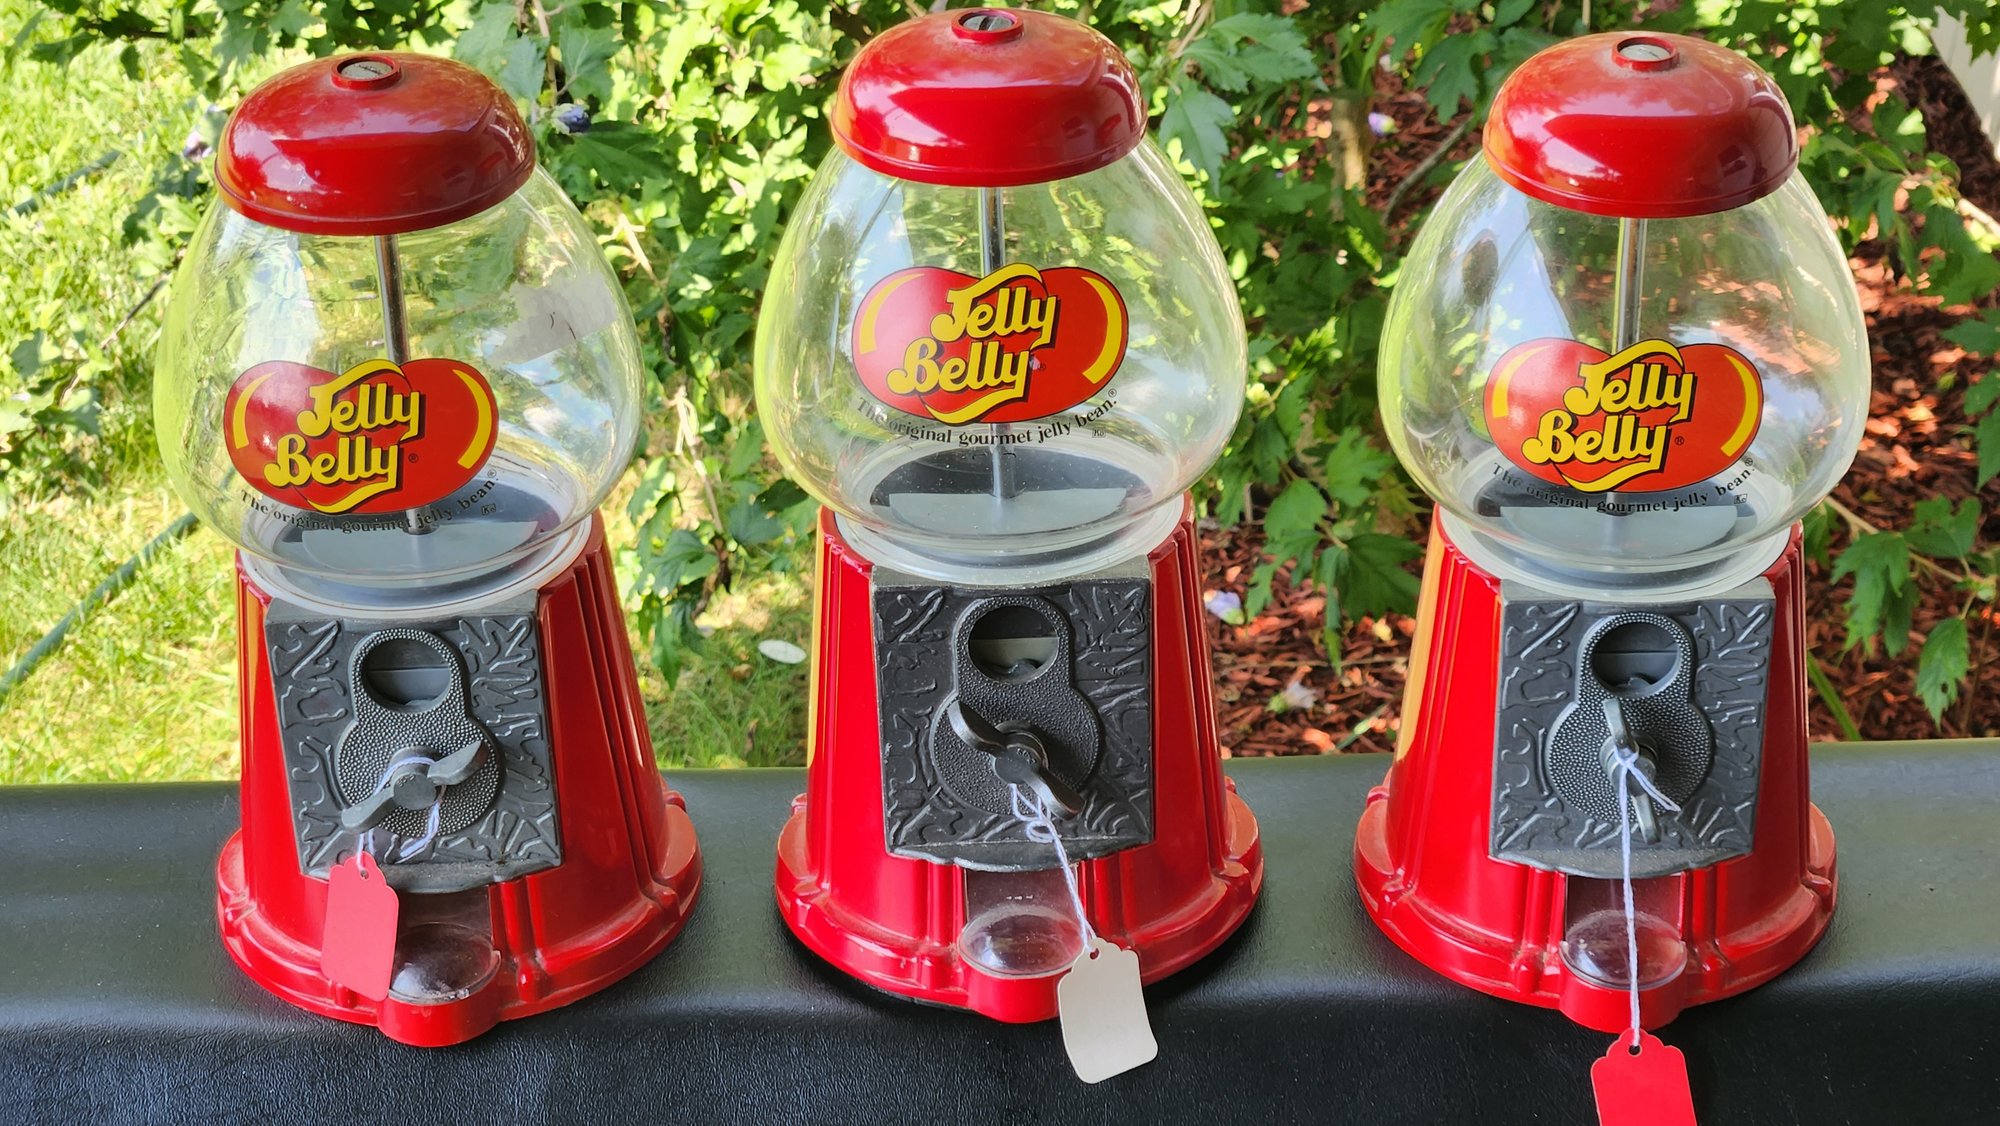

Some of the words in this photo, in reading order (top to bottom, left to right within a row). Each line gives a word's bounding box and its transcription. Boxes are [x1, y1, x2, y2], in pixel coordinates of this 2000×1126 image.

[930, 263, 1057, 350] Jelly
[297, 359, 421, 441] Jelly
[886, 337, 1031, 425] Belly
[1563, 339, 1694, 424] Jelly
[263, 433, 399, 514] Belly
[889, 419, 952, 443] original
[958, 430, 1033, 447] gourmet
[1038, 421, 1072, 443] jelly
[1521, 409, 1668, 493] Belly
[241, 489, 269, 515] The
[273, 511, 335, 531] original
[342, 518, 413, 534] gourmet
[416, 507, 453, 529] jelly
[1493, 462, 1523, 487] The
[1526, 485, 1589, 509] original
[1596, 500, 1668, 513] gourmet
[1673, 491, 1709, 512] jelly
